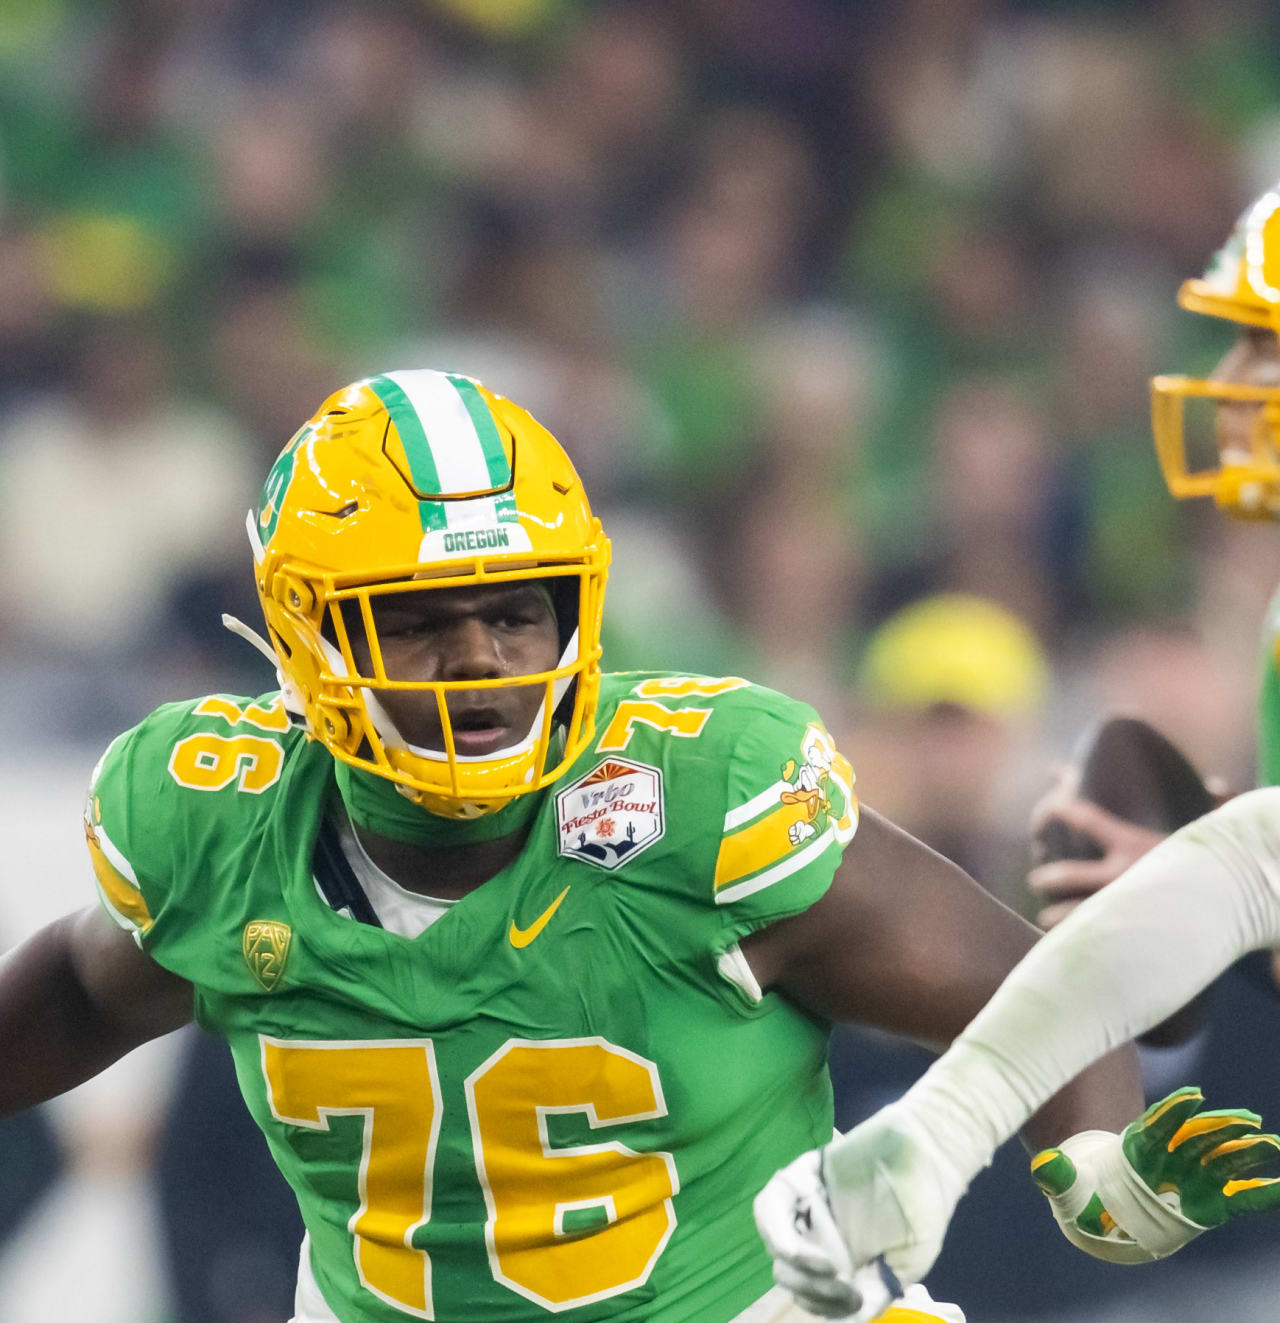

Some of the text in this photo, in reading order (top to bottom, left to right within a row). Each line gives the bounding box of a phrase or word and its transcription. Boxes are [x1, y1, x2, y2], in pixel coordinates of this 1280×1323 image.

[442, 527, 510, 553] OREGON
[561, 799, 657, 835] Fiesta Bowl
[254, 952, 277, 978] 12
[258, 1033, 680, 1322] 76
